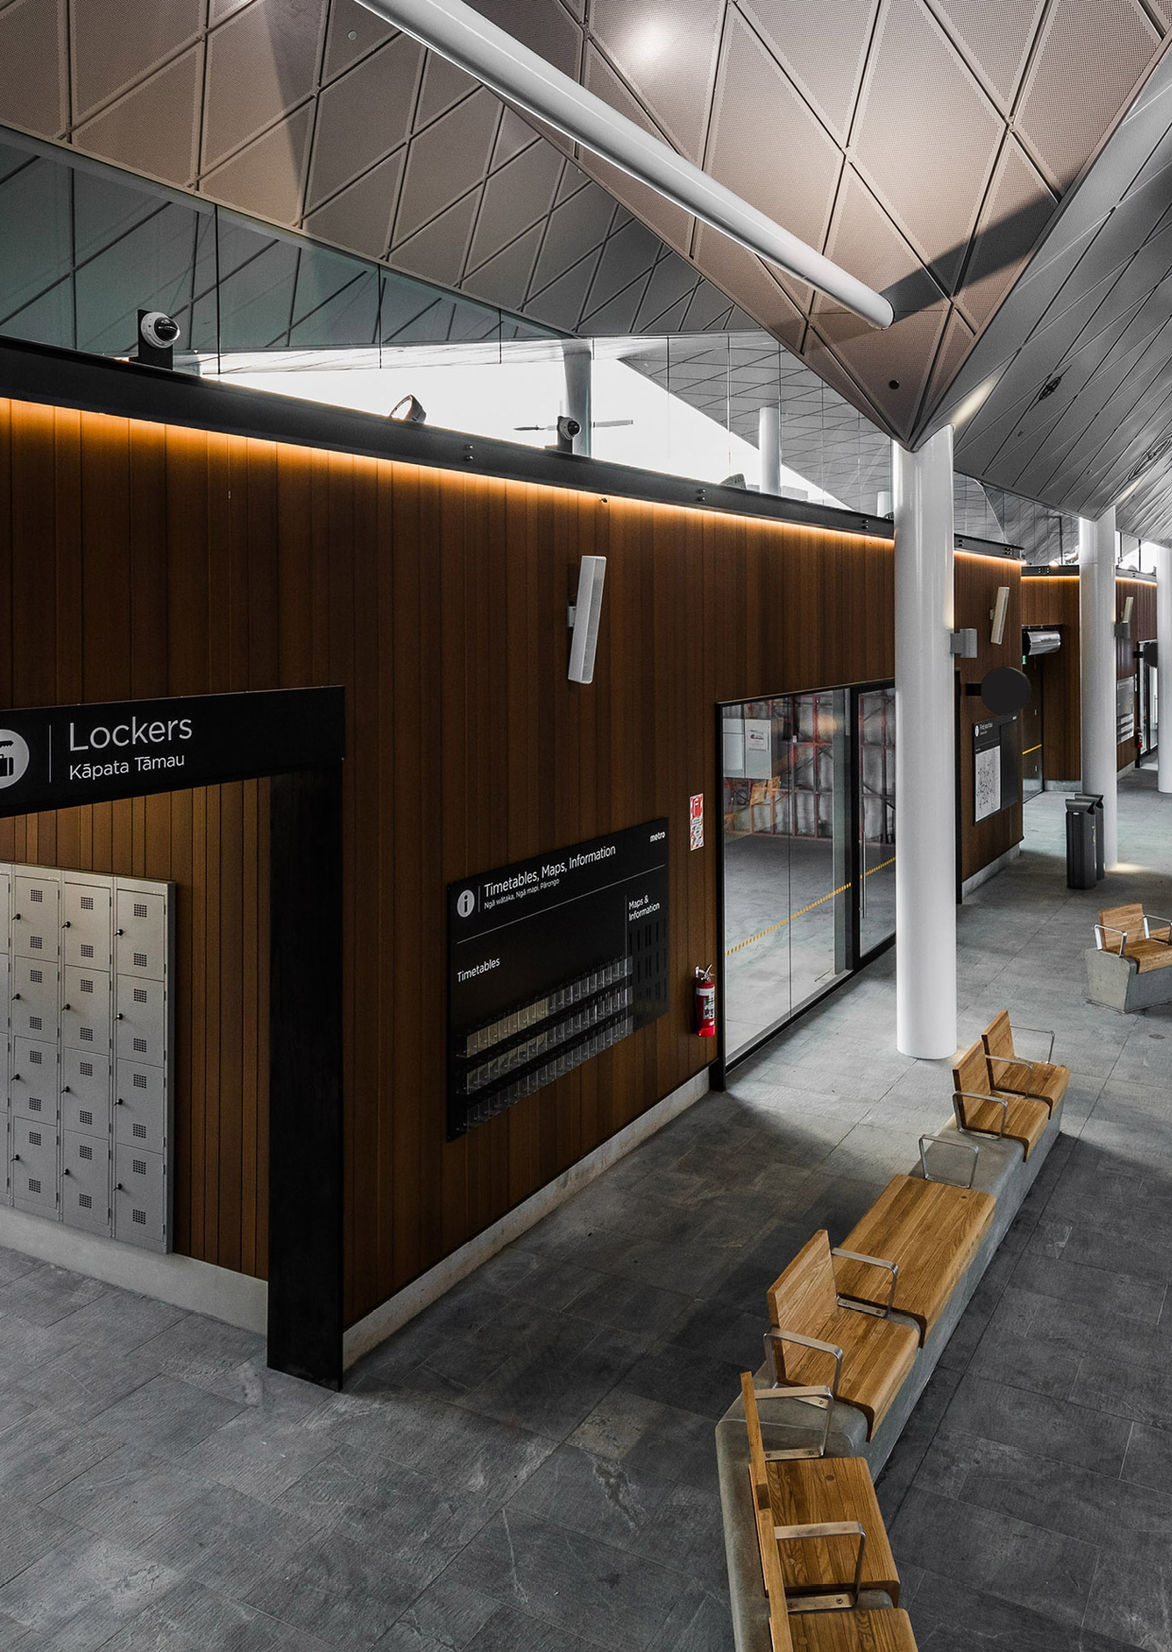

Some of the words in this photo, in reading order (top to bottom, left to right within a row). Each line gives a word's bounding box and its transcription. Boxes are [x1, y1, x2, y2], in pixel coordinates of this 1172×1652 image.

[69, 716, 193, 751] Lockers
[69, 760, 129, 781] Kāpata
[134, 754, 185, 771] Tāmau
[483, 871, 539, 897] Timetables,
[541, 862, 567, 878] Maps,
[569, 845, 616, 869] Information
[628, 898, 643, 910] Maps
[628, 902, 660, 922] Information
[457, 958, 500, 982] Timetables
